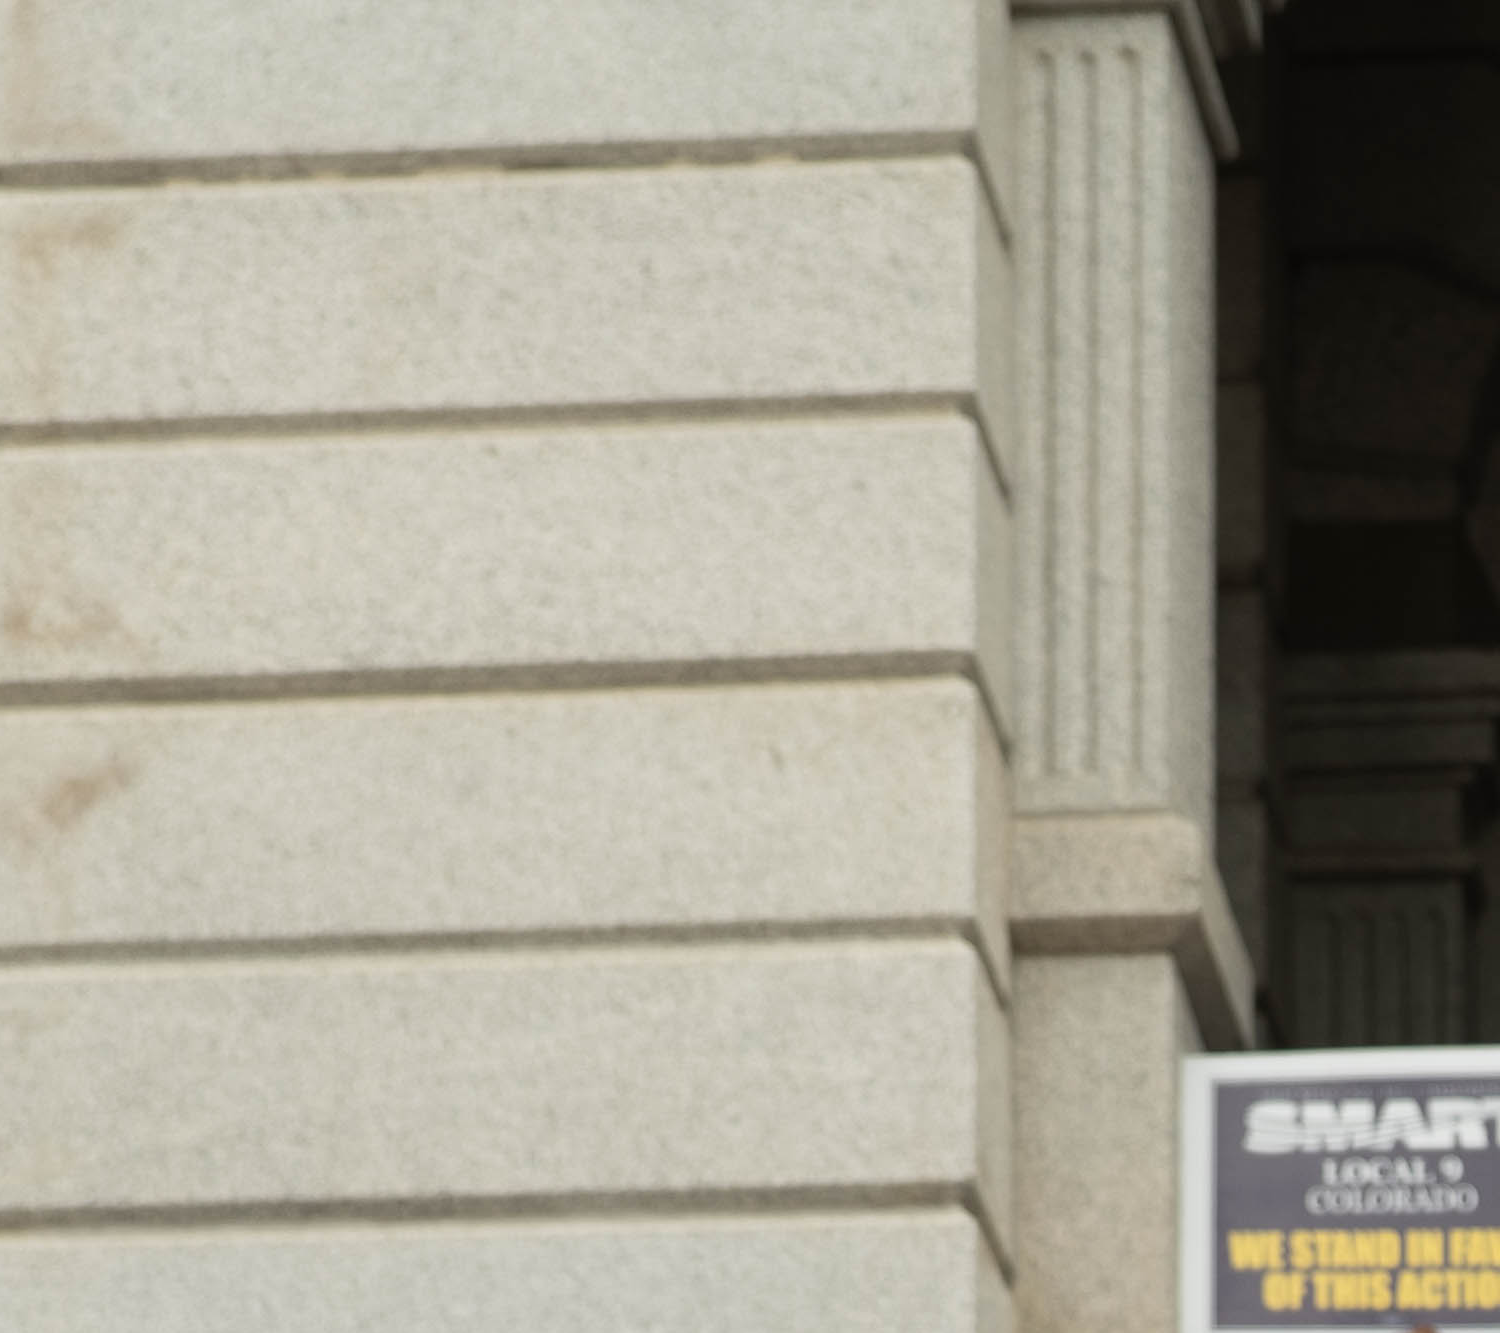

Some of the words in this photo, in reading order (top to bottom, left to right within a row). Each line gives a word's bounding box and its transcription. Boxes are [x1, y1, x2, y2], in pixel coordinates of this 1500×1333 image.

[1322, 1157, 1436, 1185] LOCAL
[1305, 1183, 1479, 1215] COLORADO
[1227, 1227, 1285, 1271] WE
[1289, 1227, 1401, 1269] STAND
[1405, 1226, 1445, 1268] IN
[1262, 1269, 1307, 1312] OF
[1312, 1269, 1393, 1311] THIS
